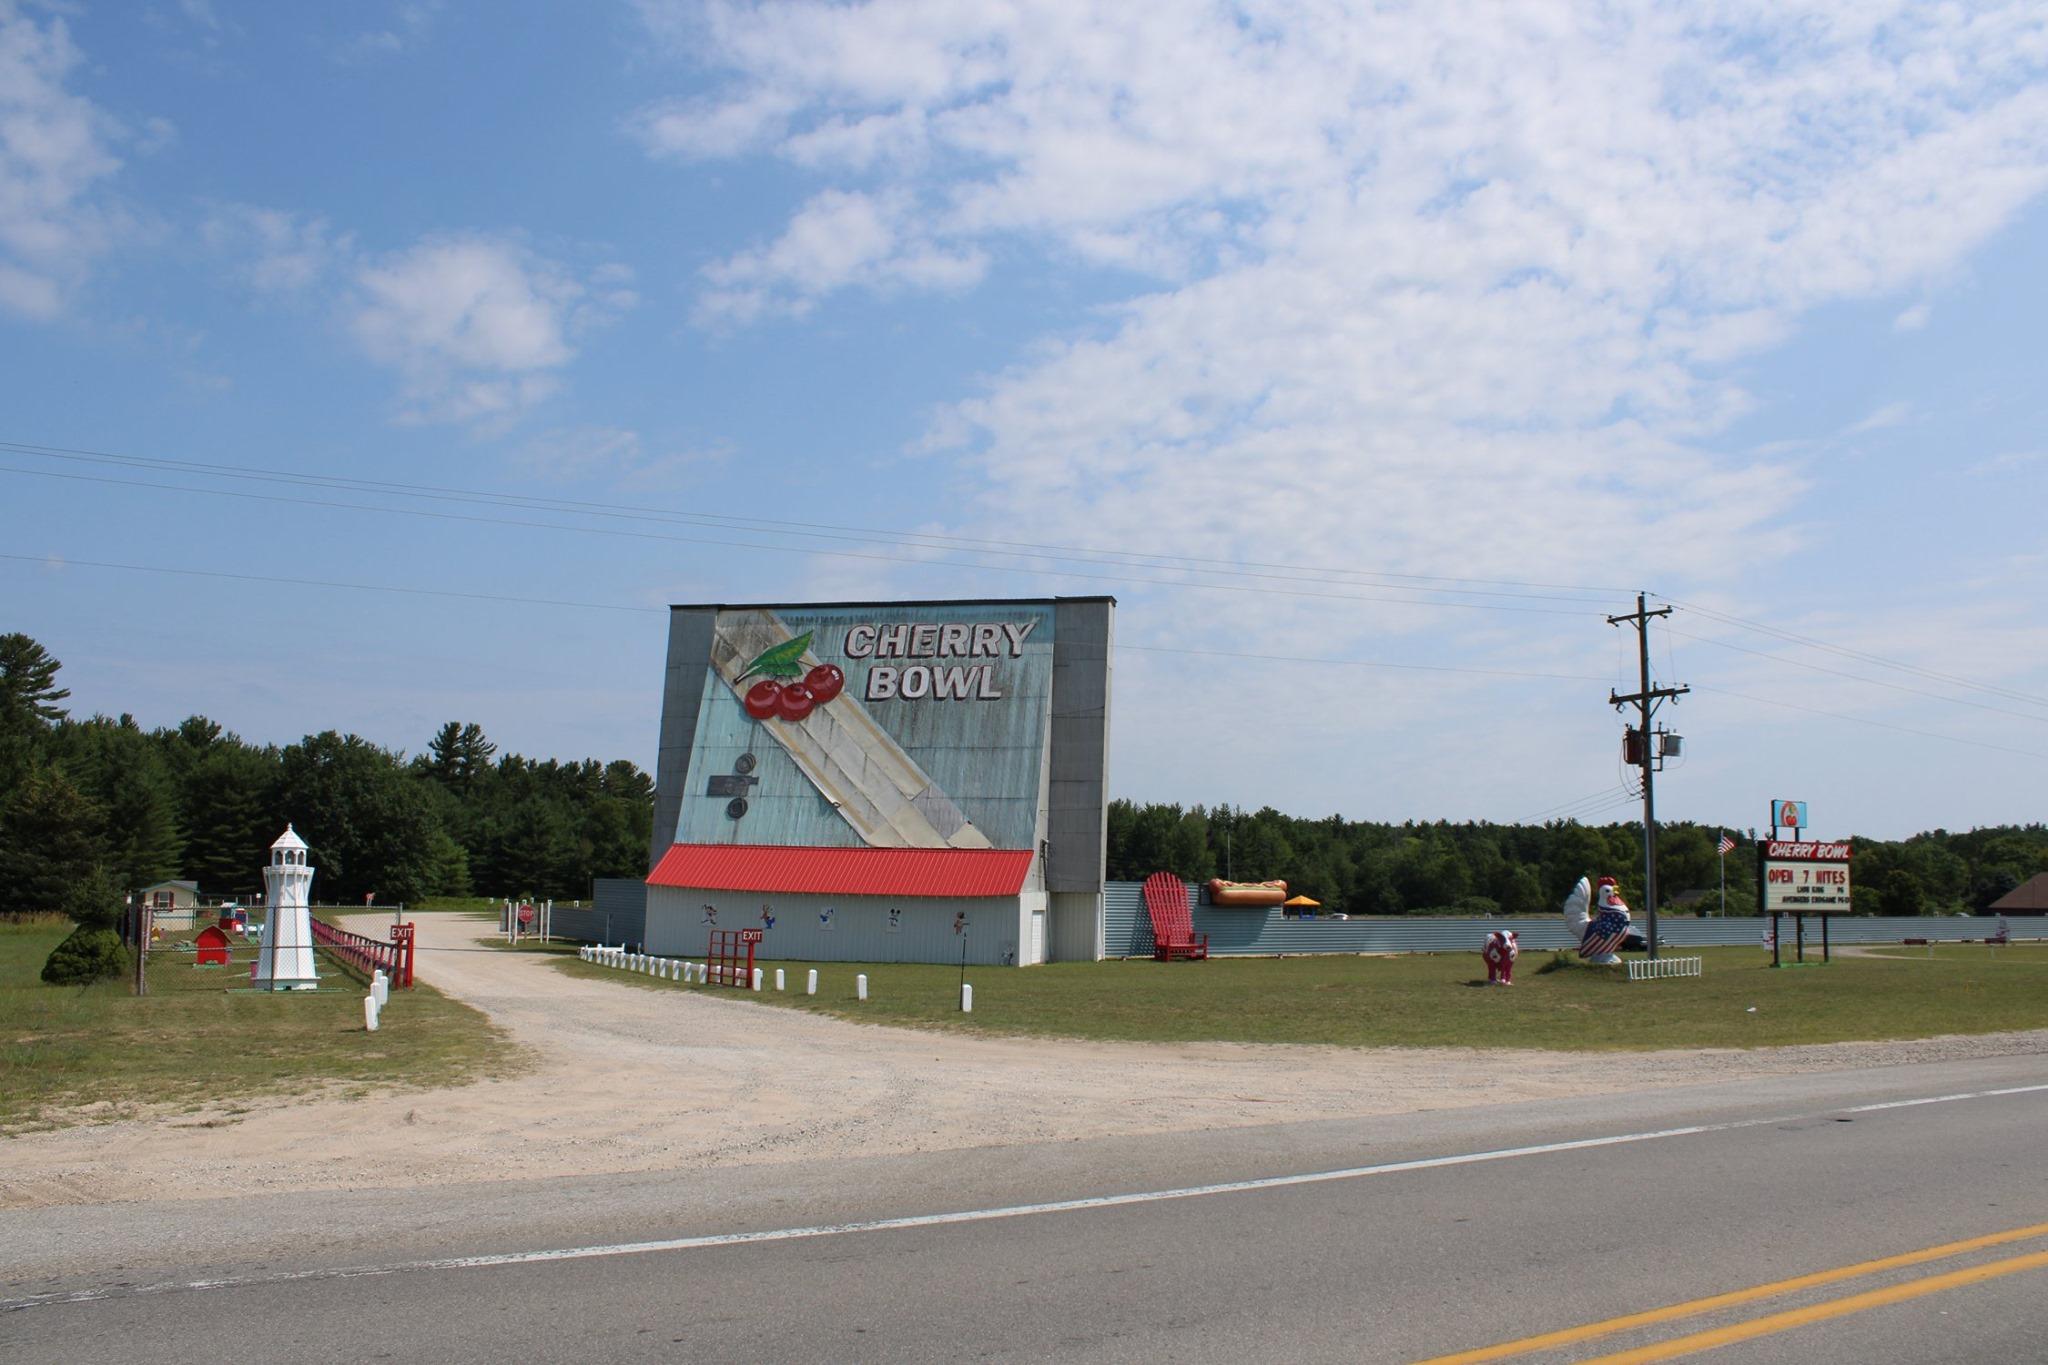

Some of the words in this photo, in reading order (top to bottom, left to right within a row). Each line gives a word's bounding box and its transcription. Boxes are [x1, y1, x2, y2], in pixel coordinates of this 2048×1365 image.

[844, 619, 1038, 659] CHERRY
[865, 665, 1002, 701] BOWL
[1769, 843, 1816, 858] CHERRY
[1817, 845, 1849, 858] BOWL
[1769, 869, 1793, 883] OPEN
[1803, 870, 1809, 883] 7
[1816, 871, 1845, 883] NITES
[391, 927, 412, 938] EXIT
[743, 931, 762, 939] EXIT
